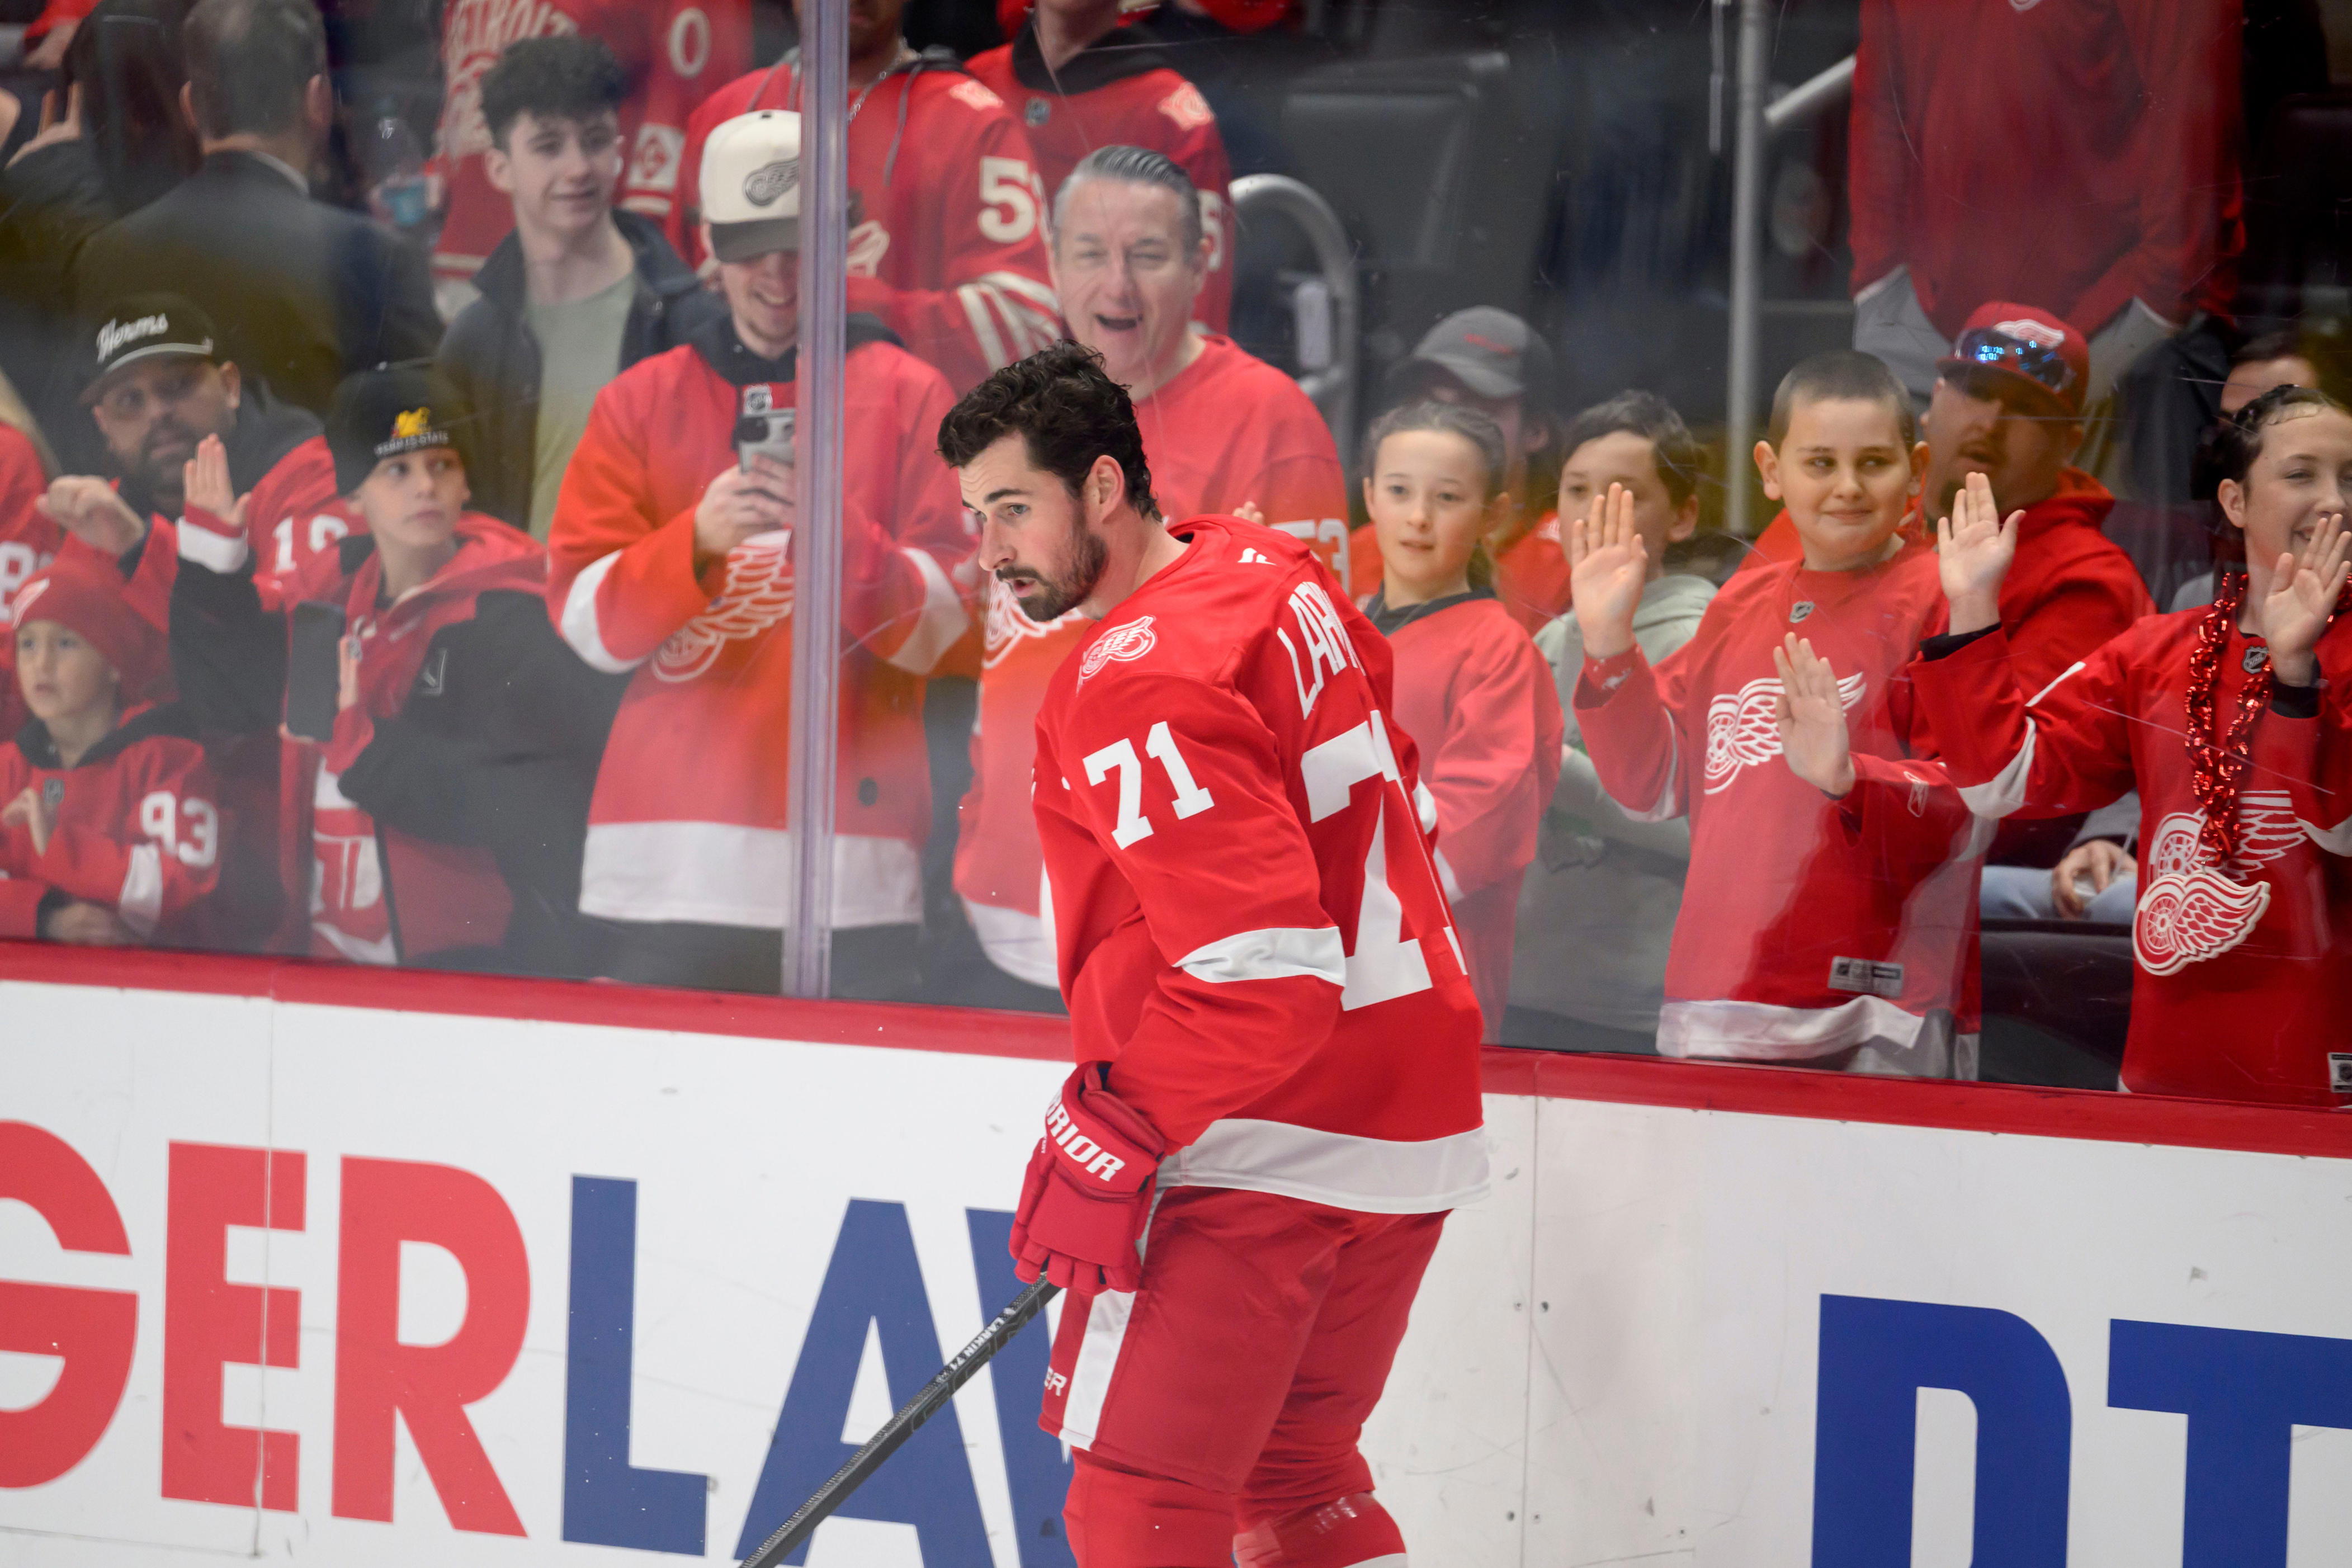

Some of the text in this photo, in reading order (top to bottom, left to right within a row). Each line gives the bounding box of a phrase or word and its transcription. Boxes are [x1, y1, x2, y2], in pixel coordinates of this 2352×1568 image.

[977, 155, 1051, 245] 5
[1277, 581, 1366, 720] LAR
[140, 790, 219, 867] 93
[1083, 721, 1215, 851] 71
[948, 1316, 1005, 1371] LARKIN 71
